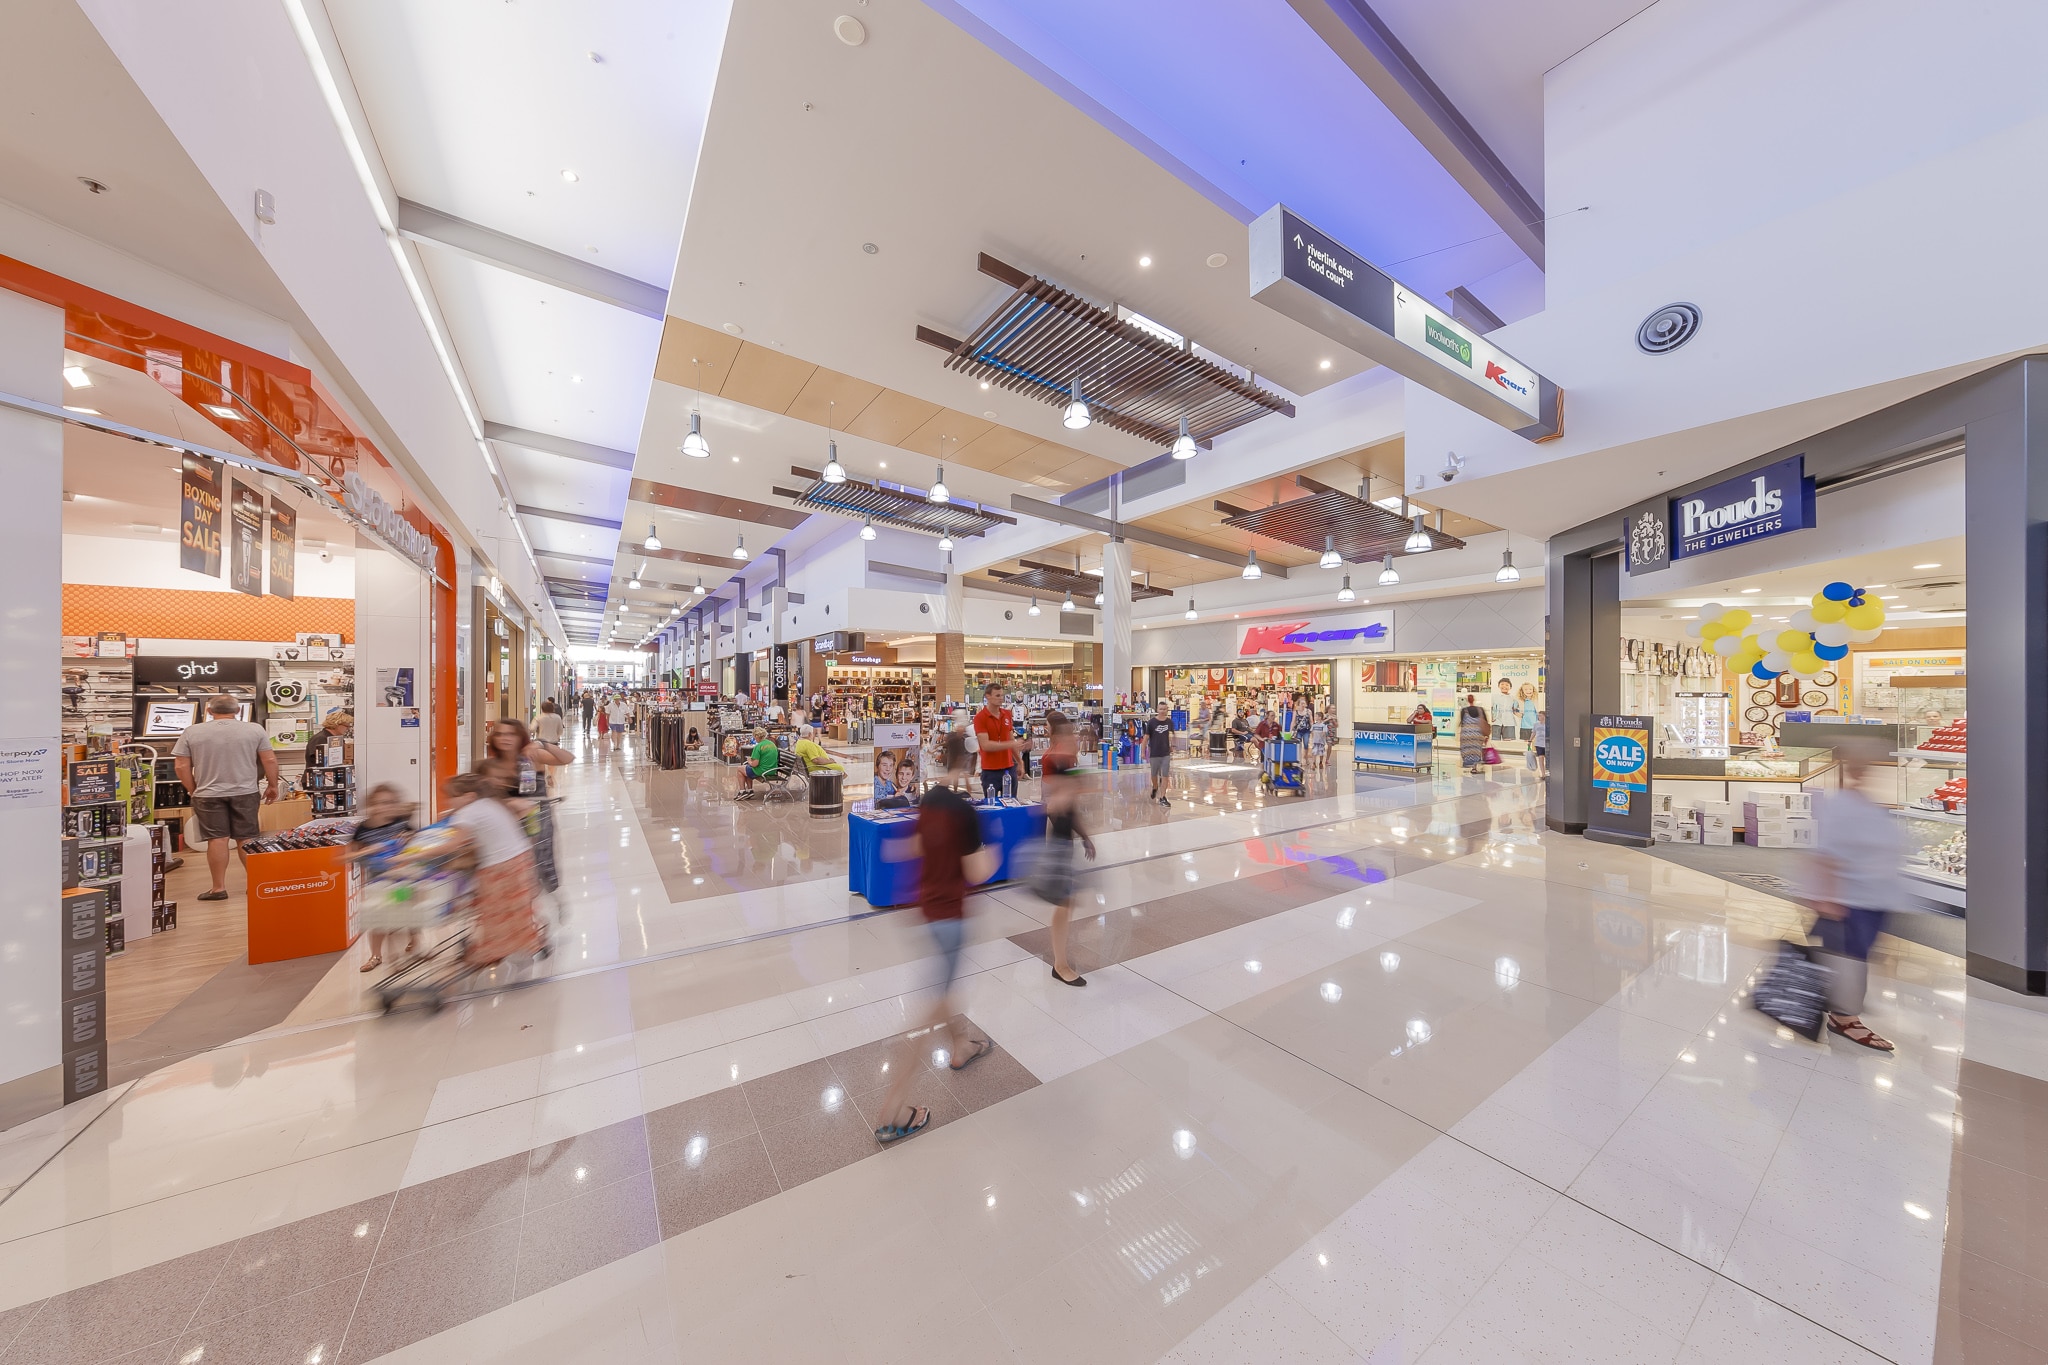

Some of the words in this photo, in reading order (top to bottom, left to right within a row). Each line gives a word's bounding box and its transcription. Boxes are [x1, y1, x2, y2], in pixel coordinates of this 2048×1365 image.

[1307, 243, 1337, 271] riverlink
[1338, 264, 1354, 281] east
[1307, 256, 1325, 275] food
[1326, 269, 1345, 288] court
[1427, 324, 1460, 354] Woolworths
[1485, 360, 1527, 396] Kmart
[184, 482, 221, 512] BOXING
[1682, 475, 1783, 538] Prouds
[194, 504, 213, 526] DAY
[183, 520, 220, 556] SALE
[271, 526, 294, 548] BOXING
[1685, 540, 1706, 552] THE
[1710, 518, 1782, 546] JEWELLERS
[278, 545, 289, 560] DAY
[271, 558, 293, 582] SALE
[1239, 622, 1388, 655] Kmart
[177, 661, 218, 680] ghd
[775, 656, 784, 688] colette
[852, 656, 881, 664] Strandbags
[1355, 731, 1398, 741] RIVERLINK
[1616, 717, 1642, 725] Prouds
[0, 750, 34, 758] terpay
[1598, 744, 1641, 761] SALE
[77, 766, 109, 776] SALE
[72, 899, 96, 940] HEAD
[73, 949, 96, 991] HEAD
[73, 1000, 97, 1042] HEAD
[75, 1050, 98, 1094] HEAD
